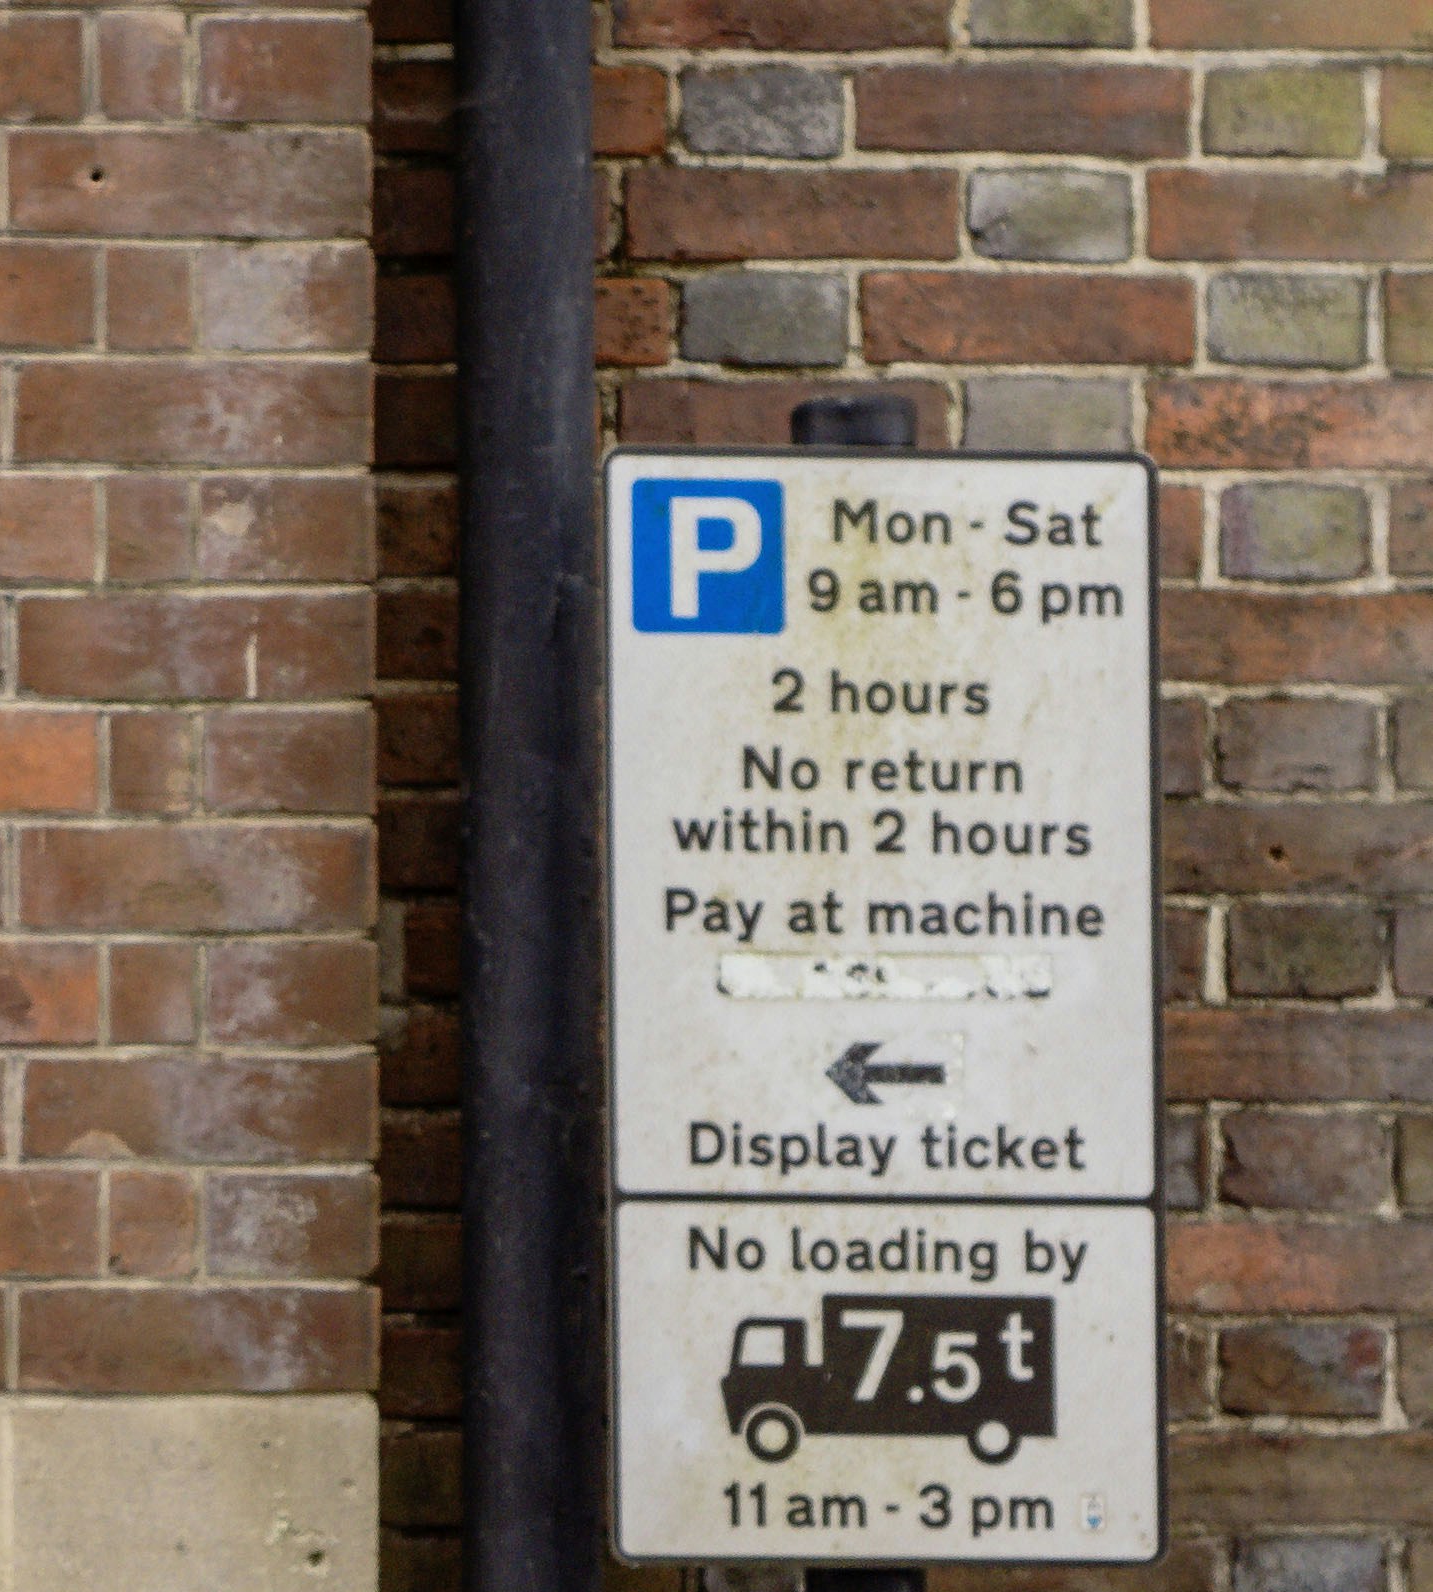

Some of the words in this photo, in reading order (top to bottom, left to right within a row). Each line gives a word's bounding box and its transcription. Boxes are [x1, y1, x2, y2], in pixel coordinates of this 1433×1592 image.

[832, 498, 952, 545] Mon
[1003, 500, 1102, 548] Sat
[669, 496, 762, 619] P
[771, 667, 805, 714] 2
[830, 669, 990, 716] hours
[742, 745, 820, 792] No
[845, 749, 1023, 793] return
[672, 808, 849, 854] within
[872, 808, 906, 854] 2
[932, 810, 1092, 857] hours
[664, 887, 763, 944] Pay
[787, 891, 843, 935] at
[867, 891, 1104, 938] machine
[689, 1121, 896, 1178] Display
[920, 1124, 1086, 1171] ticket
[688, 1226, 766, 1272] No
[790, 1226, 998, 1284] loading
[1024, 1229, 1088, 1284] by
